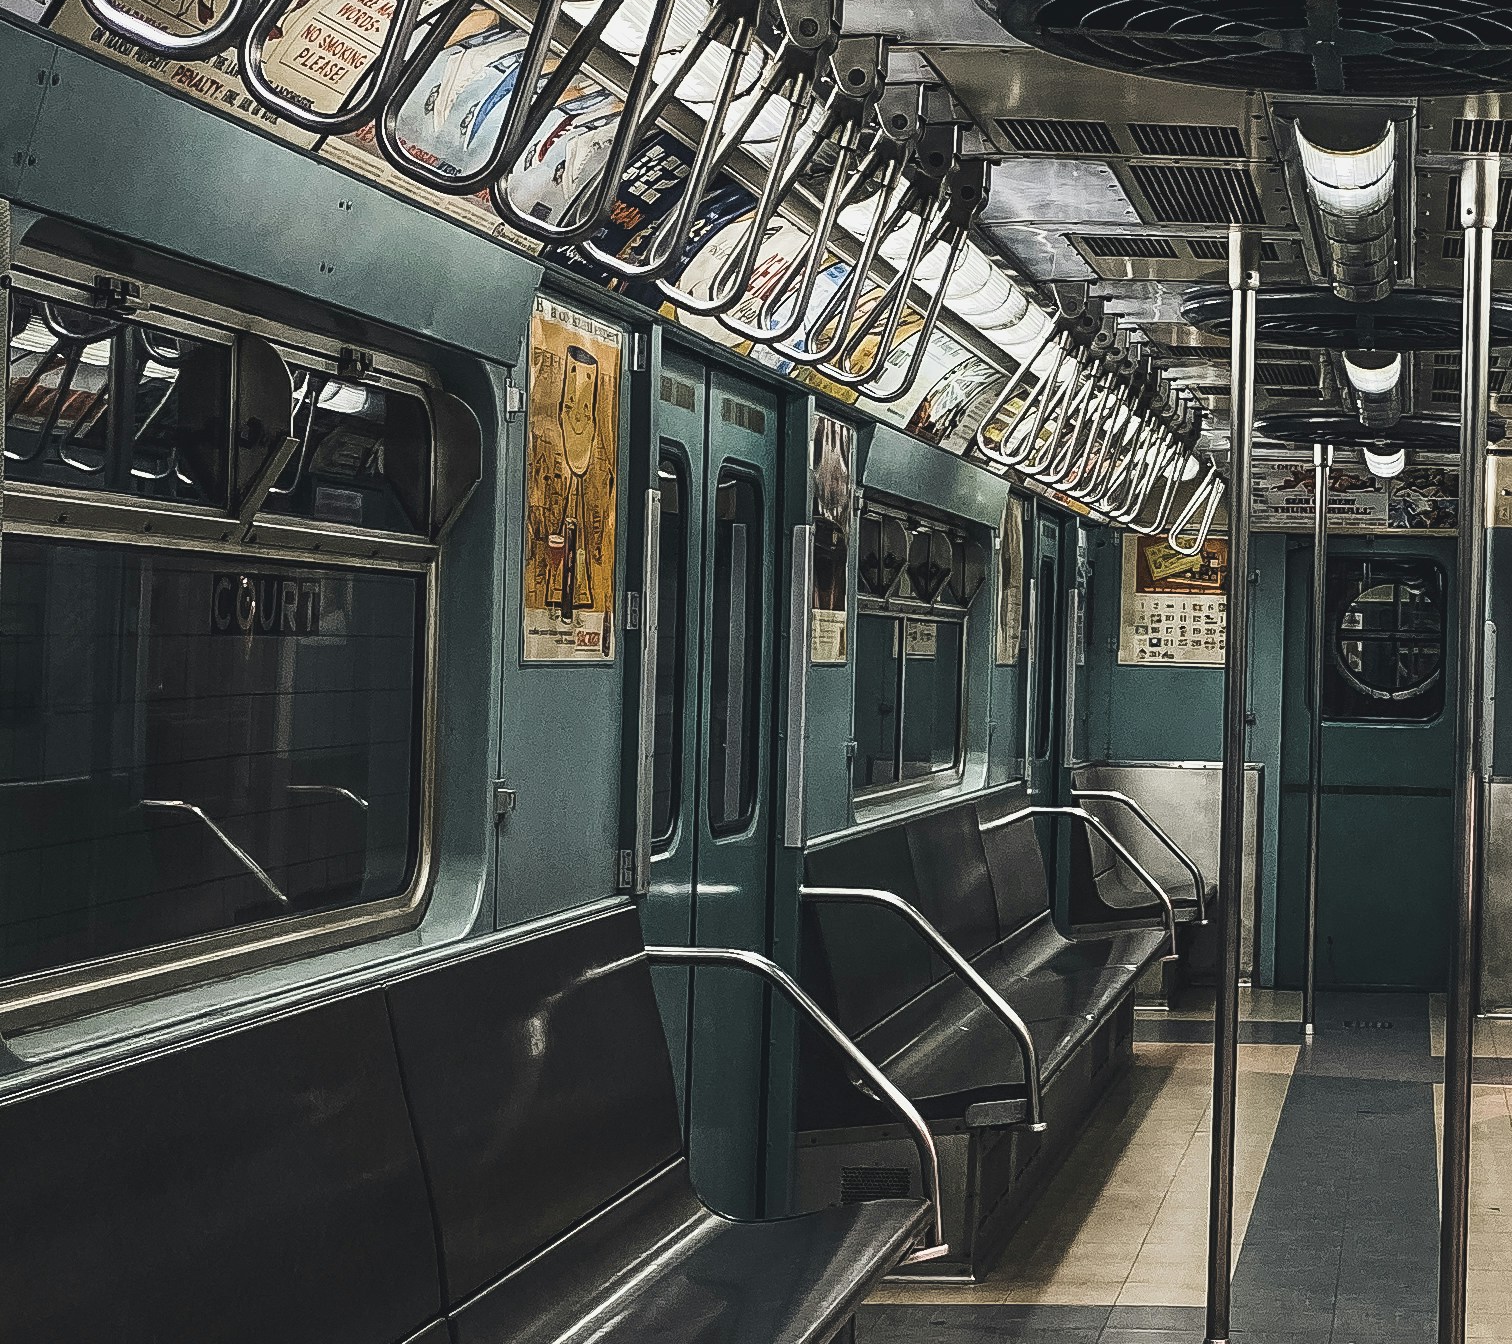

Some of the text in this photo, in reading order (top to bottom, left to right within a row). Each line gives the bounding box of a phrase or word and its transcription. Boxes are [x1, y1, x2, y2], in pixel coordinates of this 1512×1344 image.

[293, 47, 350, 85] PLEASE!
[301, 23, 369, 69] NO SMOKING
[172, 65, 227, 101] PENALTY:
[215, 576, 320, 632] COURT
